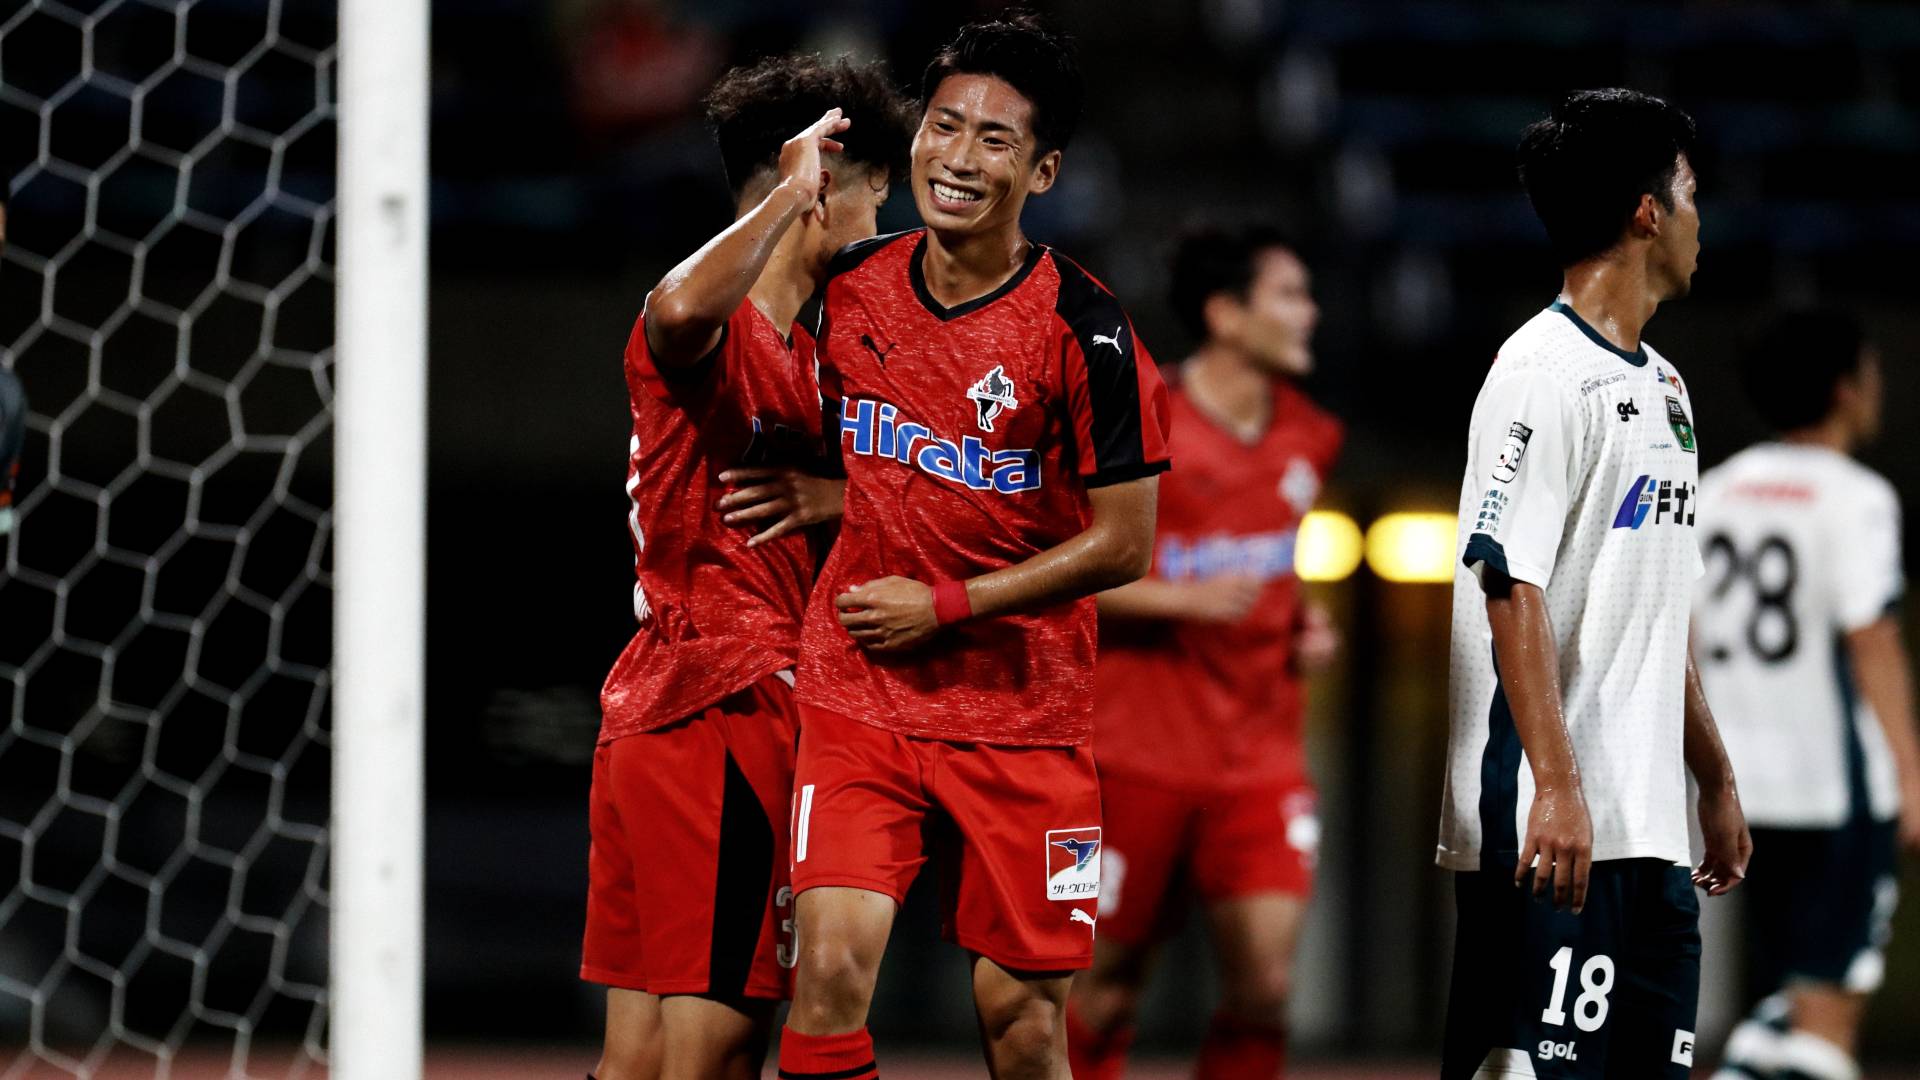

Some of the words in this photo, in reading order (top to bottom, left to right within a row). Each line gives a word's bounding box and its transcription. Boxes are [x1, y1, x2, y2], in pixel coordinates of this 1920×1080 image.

[841, 396, 1041, 494] Hirata
[1702, 531, 1798, 664] 28
[1541, 946, 1615, 1032] 18
[1537, 1040, 1578, 1061] gol.
